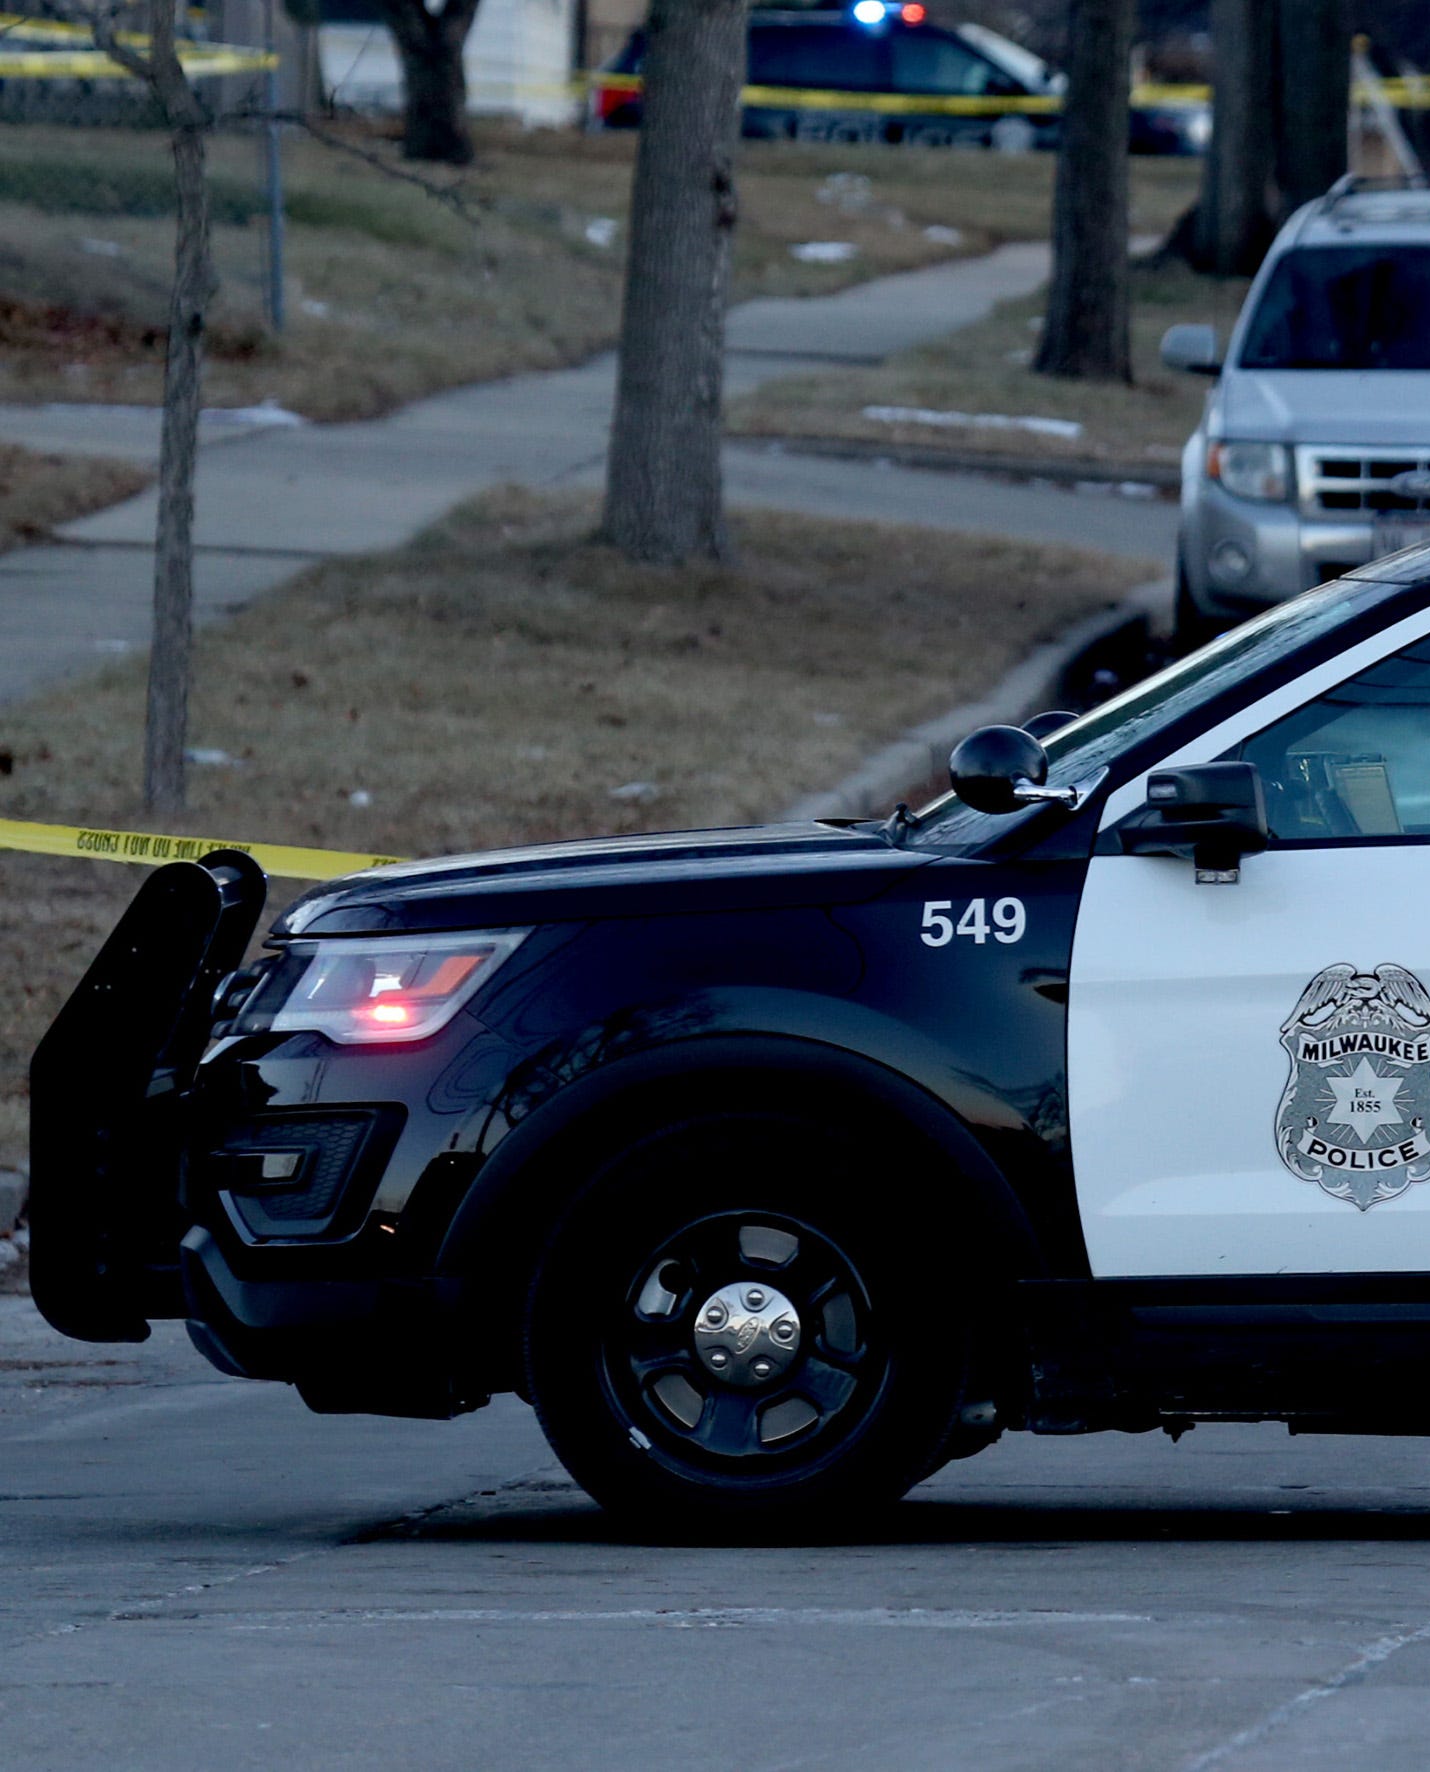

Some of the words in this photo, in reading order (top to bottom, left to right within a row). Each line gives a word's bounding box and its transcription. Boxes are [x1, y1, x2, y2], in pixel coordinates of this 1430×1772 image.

[920, 897, 1026, 947] 549
[1302, 1034, 1429, 1061] MILWAUKEE
[1350, 1101, 1381, 1113] 1855
[1354, 1088, 1376, 1099] Est.
[1307, 1140, 1419, 1169] POLICE
